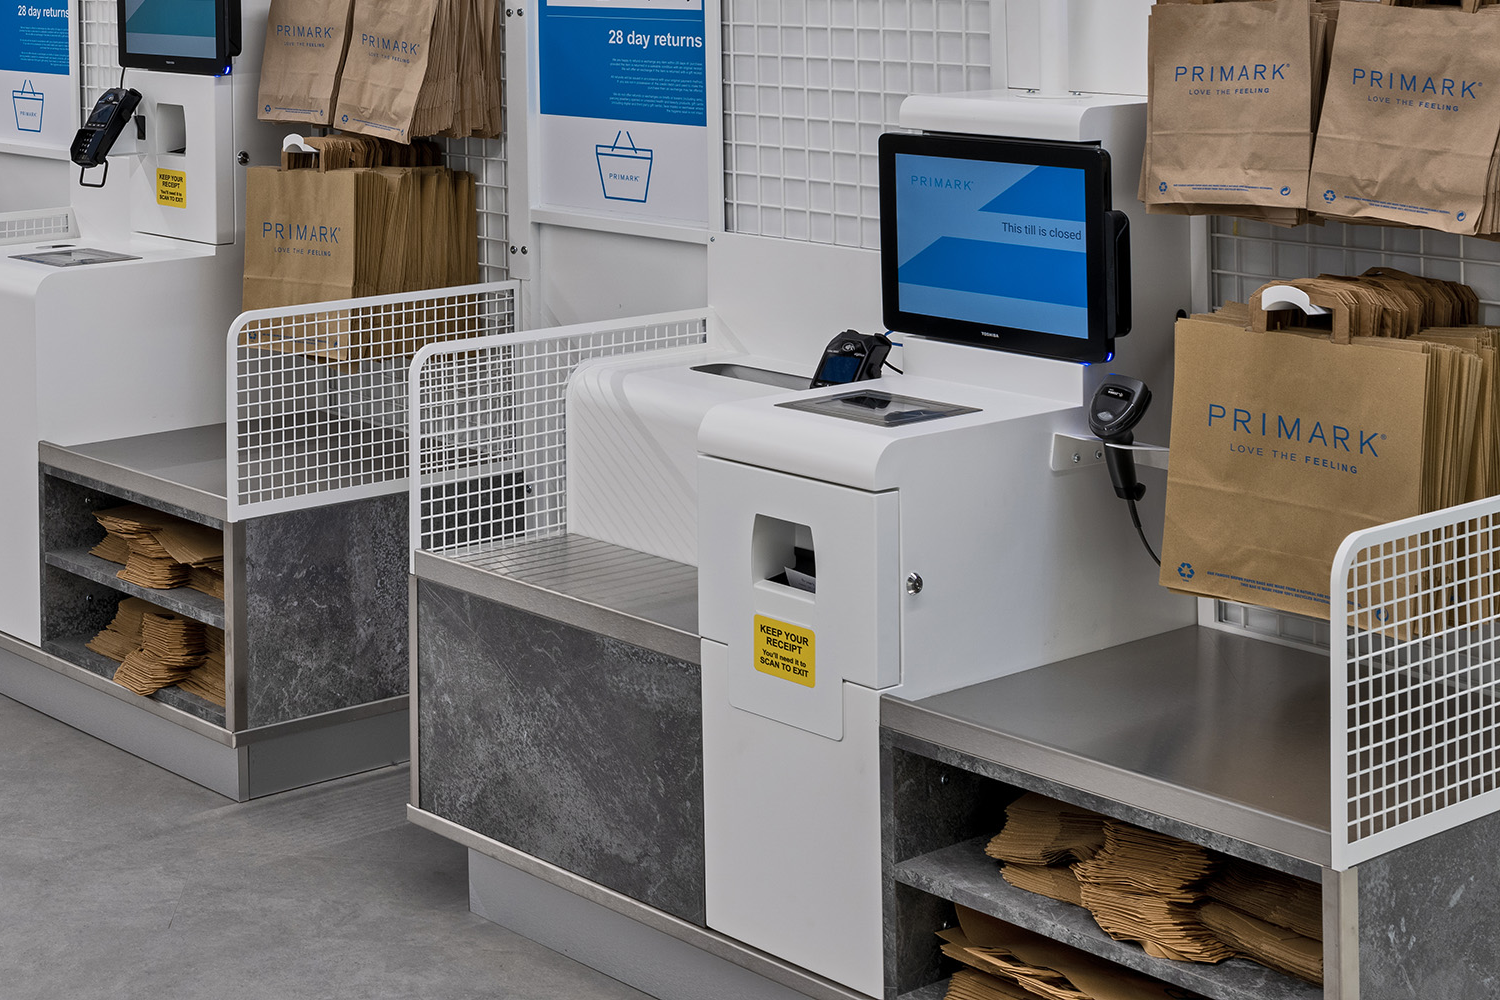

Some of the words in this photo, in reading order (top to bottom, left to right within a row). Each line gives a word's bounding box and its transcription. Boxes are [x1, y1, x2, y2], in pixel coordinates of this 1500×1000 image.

[17, 5, 26, 16] 28
[28, 6, 41, 19] day
[43, 7, 69, 18] returns
[608, 30, 623, 44] 28
[627, 30, 650, 49] day
[654, 32, 703, 47] returns
[1368, 96, 1391, 104] LOVE
[1396, 98, 1414, 107] THE
[1418, 101, 1459, 112] FEELING
[162, 181, 180, 189] RECEIPT
[1002, 222, 1022, 234] This
[1024, 224, 1036, 235] till
[1039, 226, 1047, 237] is
[1049, 228, 1082, 240] closed
[293, 247, 304, 255] THE
[1230, 443, 1263, 457] LOVE
[1272, 450, 1297, 462] THE
[1305, 456, 1358, 474] FEELING
[760, 624, 783, 637] KEEP
[784, 631, 809, 647] YOUR
[766, 636, 802, 654] RECEIPT
[762, 648, 778, 659] You'll
[779, 655, 794, 664] need
[760, 656, 780, 669] SCAN
[781, 662, 791, 672] TO
[792, 666, 809, 677] EXIT
